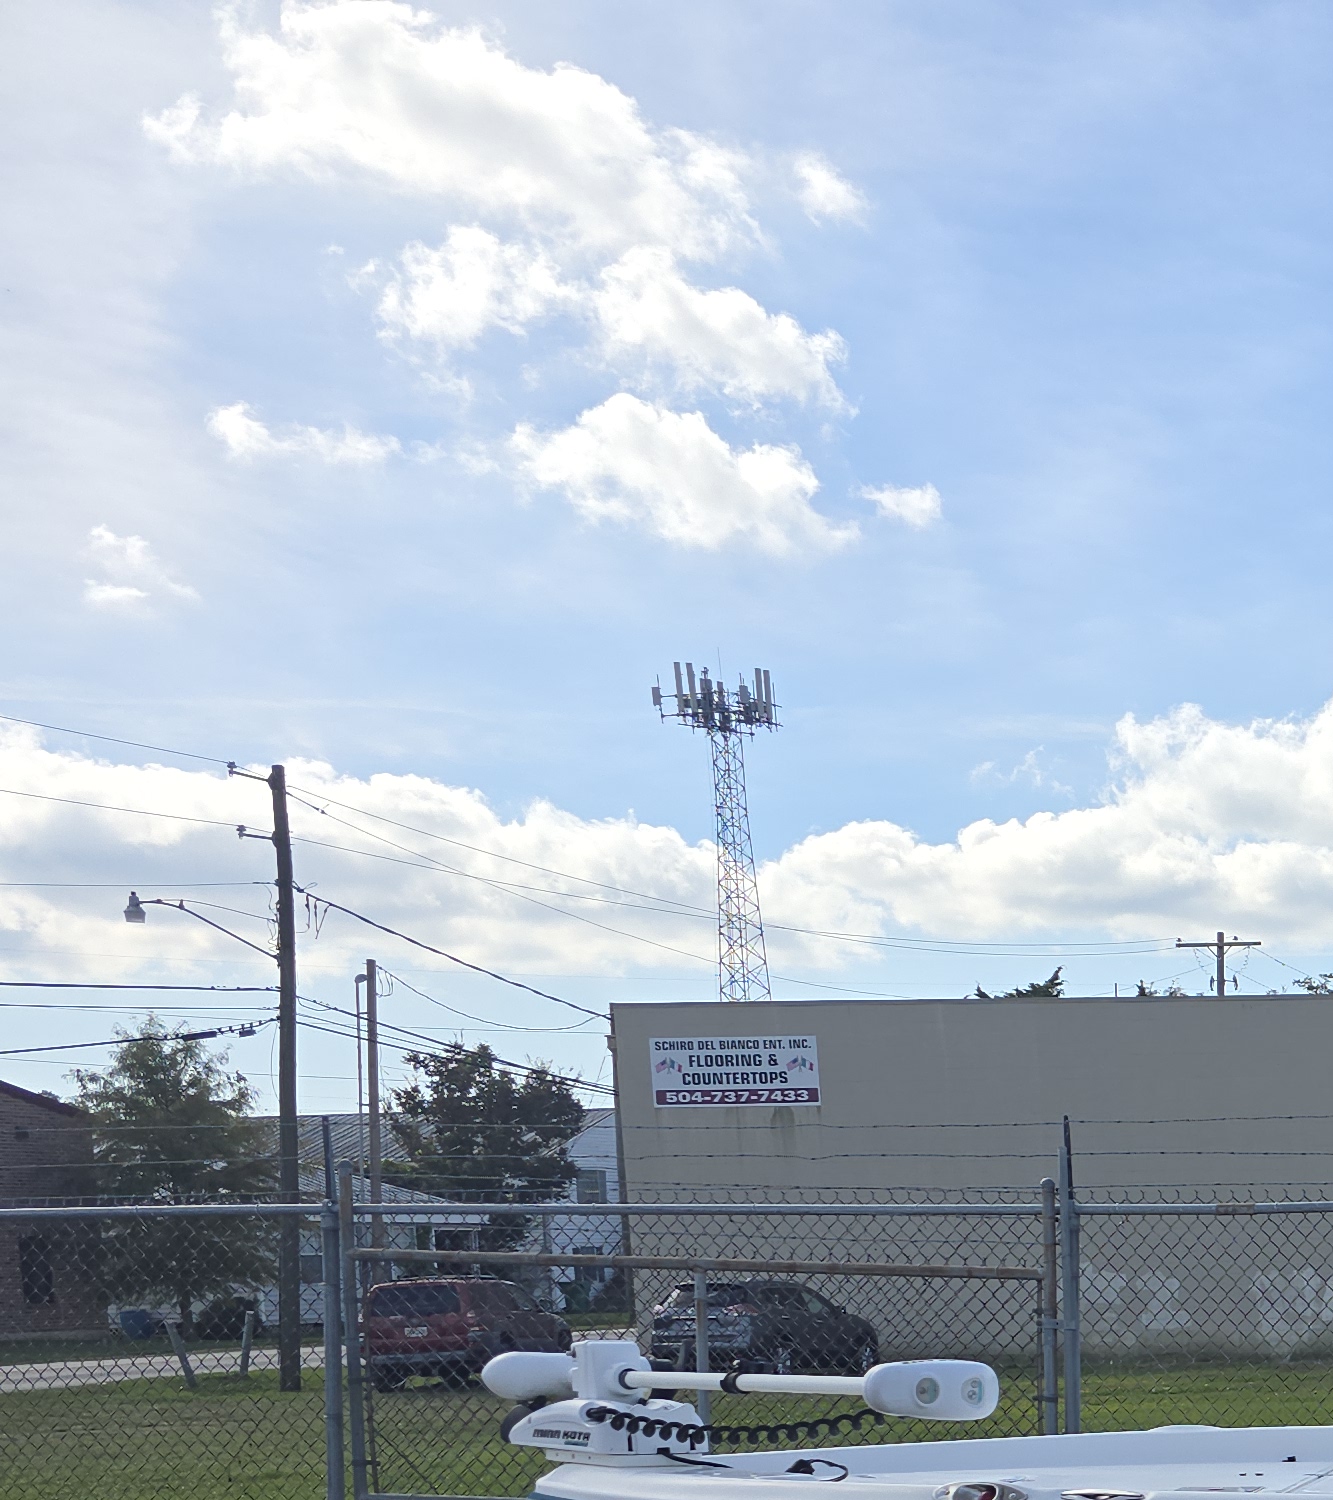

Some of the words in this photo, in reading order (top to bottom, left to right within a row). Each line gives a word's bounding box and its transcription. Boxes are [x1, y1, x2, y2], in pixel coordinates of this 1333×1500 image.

[655, 1041, 694, 1051] SCHIRO
[697, 1040, 716, 1050] DEL
[719, 1039, 760, 1050] BIANCO
[763, 1039, 785, 1050] ENT.
[788, 1039, 812, 1049] INC.
[688, 1053, 763, 1067] FLOORING
[768, 1053, 779, 1066] &
[682, 1071, 788, 1085] COUNTERTOPS
[666, 1090, 809, 1103] 504-737-7433
